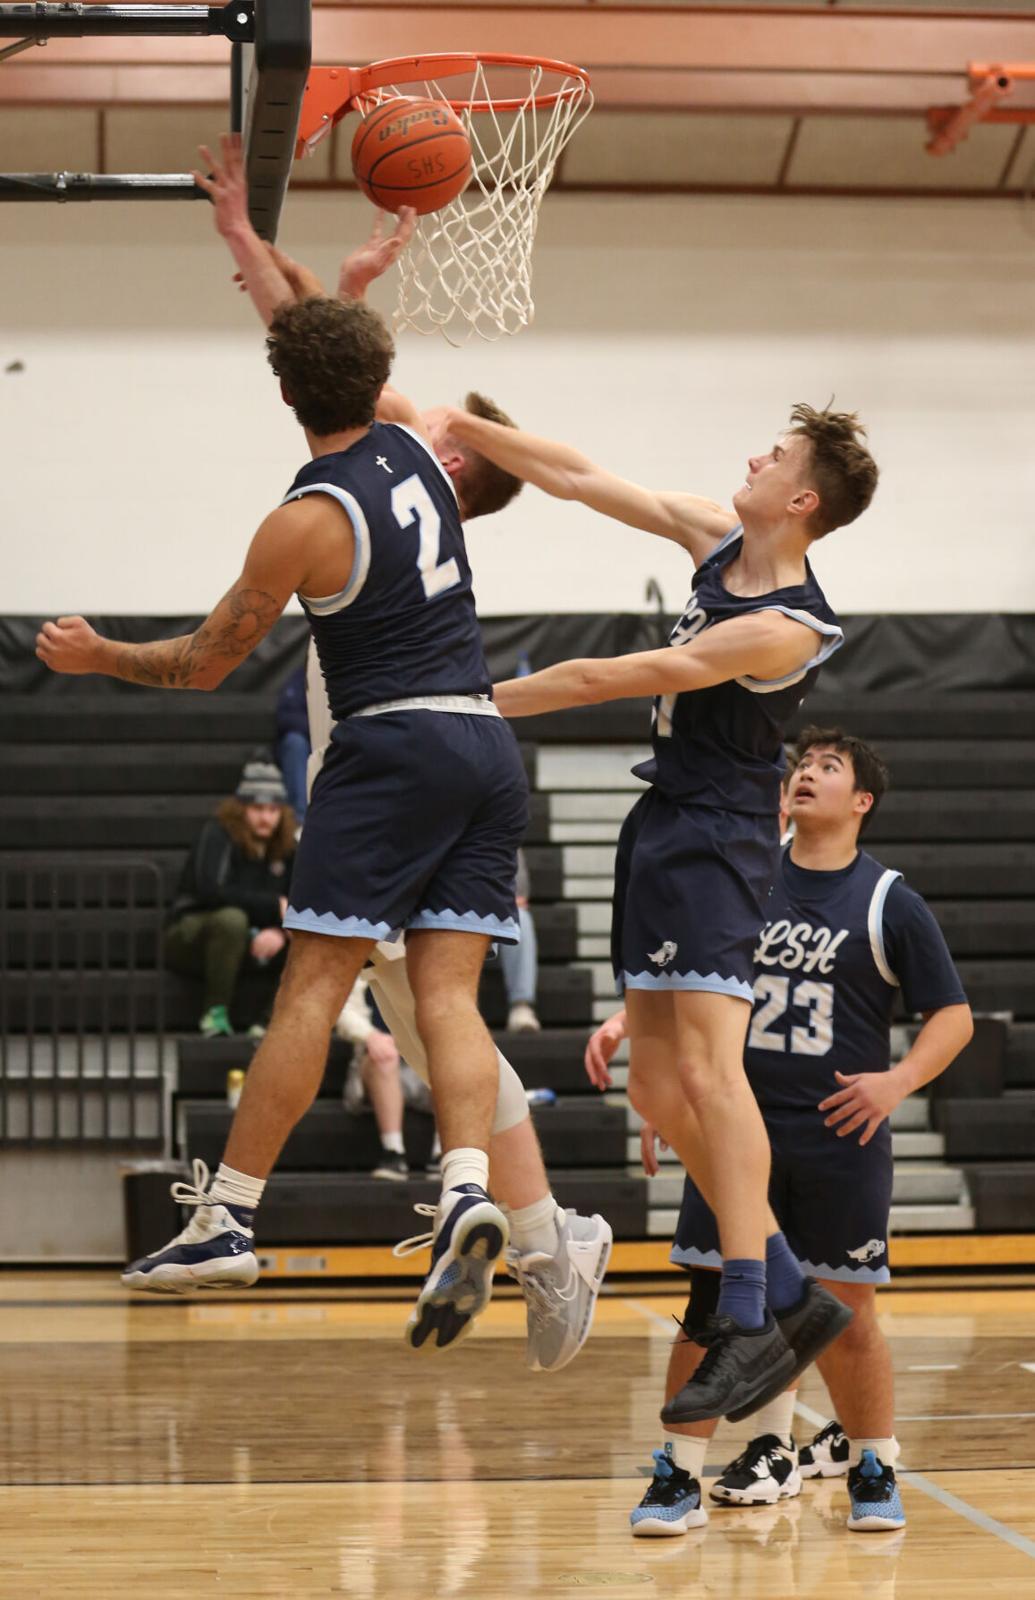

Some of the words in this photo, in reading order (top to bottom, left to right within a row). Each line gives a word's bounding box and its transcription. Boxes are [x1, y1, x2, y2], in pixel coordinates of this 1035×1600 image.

[407, 152, 446, 180] SHS
[390, 472, 462, 602] 2
[753, 919, 850, 975] LSH
[748, 973, 835, 1057] 23
